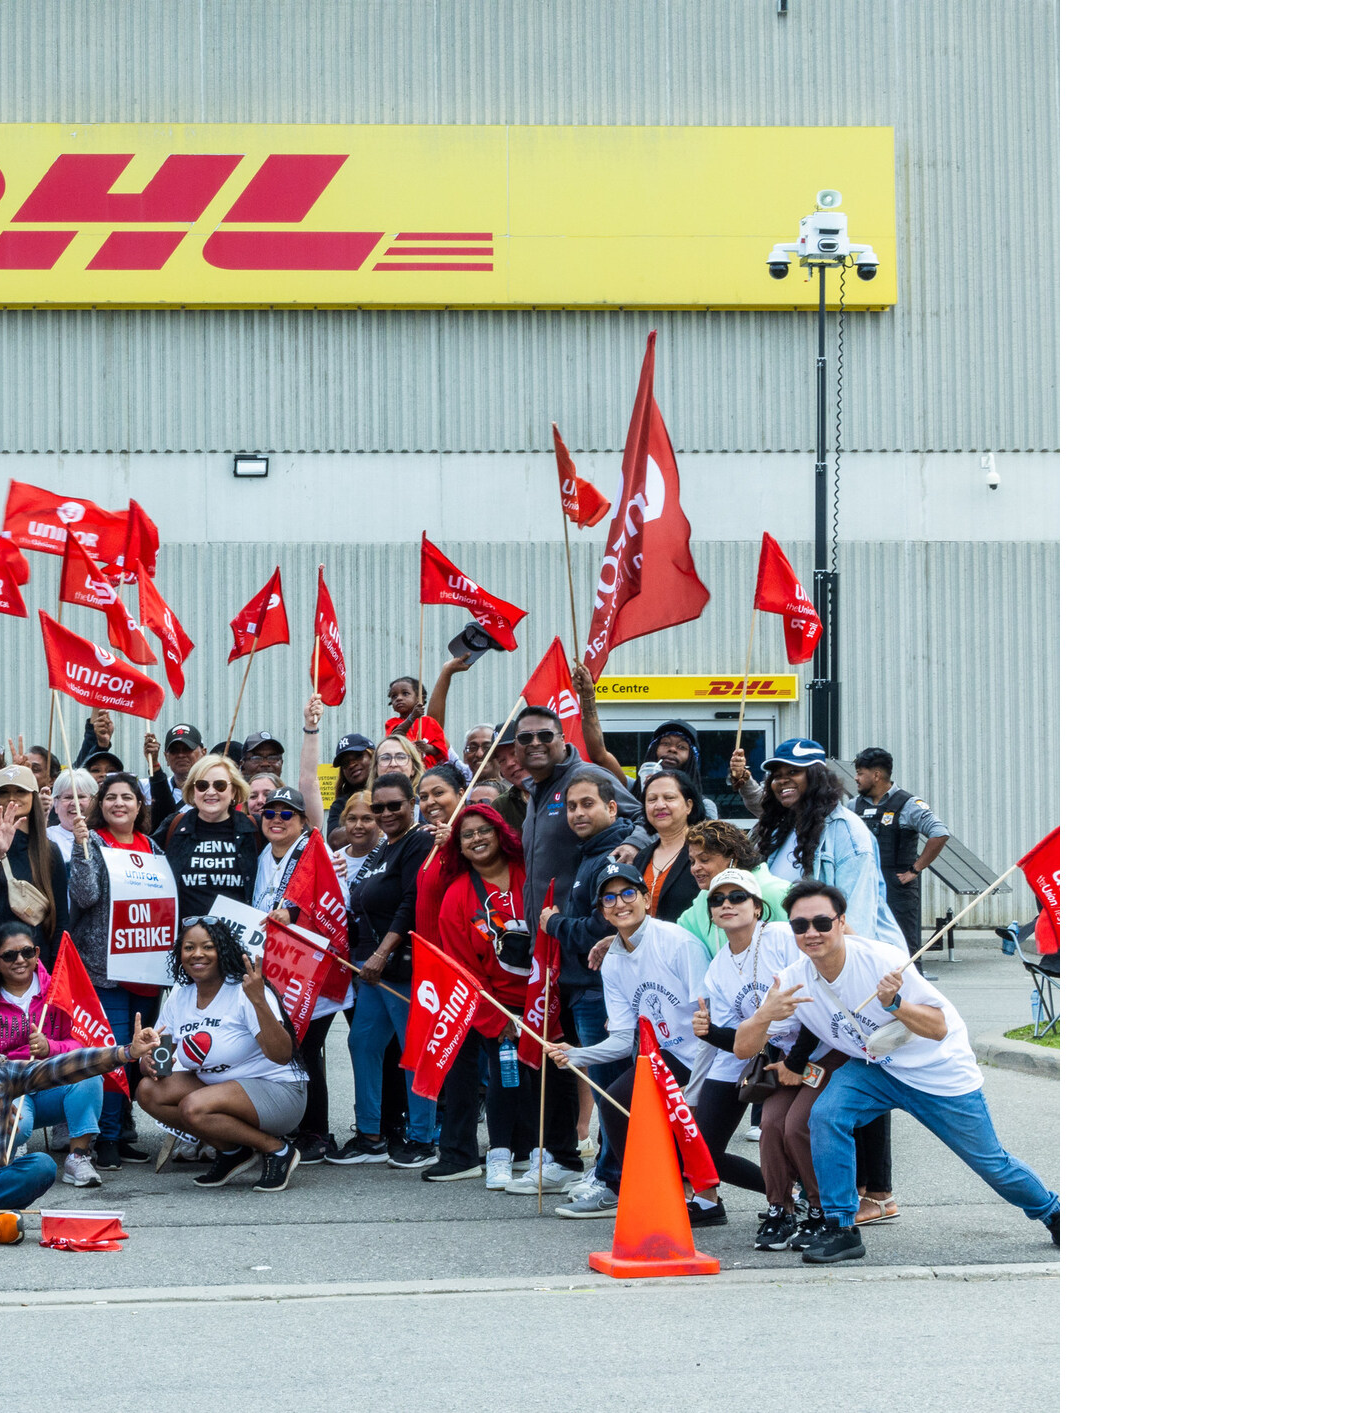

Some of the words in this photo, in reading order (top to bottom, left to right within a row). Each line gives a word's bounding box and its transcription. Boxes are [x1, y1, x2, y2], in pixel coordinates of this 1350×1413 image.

[28, 521, 99, 547] UNIOR
[440, 590, 477, 605] theUnion
[66, 661, 134, 695] UNIFOR
[611, 683, 649, 694] Centre
[707, 681, 778, 695] DHL
[95, 692, 134, 708] lesyndicat
[274, 789, 291, 800] LA
[194, 841, 221, 853] HEN
[191, 857, 235, 869] FIGHT
[606, 863, 620, 875] LA
[182, 874, 207, 887] WE
[128, 902, 151, 924] ON
[315, 911, 337, 935] Union
[114, 926, 171, 949] STRIKE
[72, 1025, 88, 1041] nion
[179, 1022, 200, 1035] FOR
[201, 1017, 221, 1027] THE
